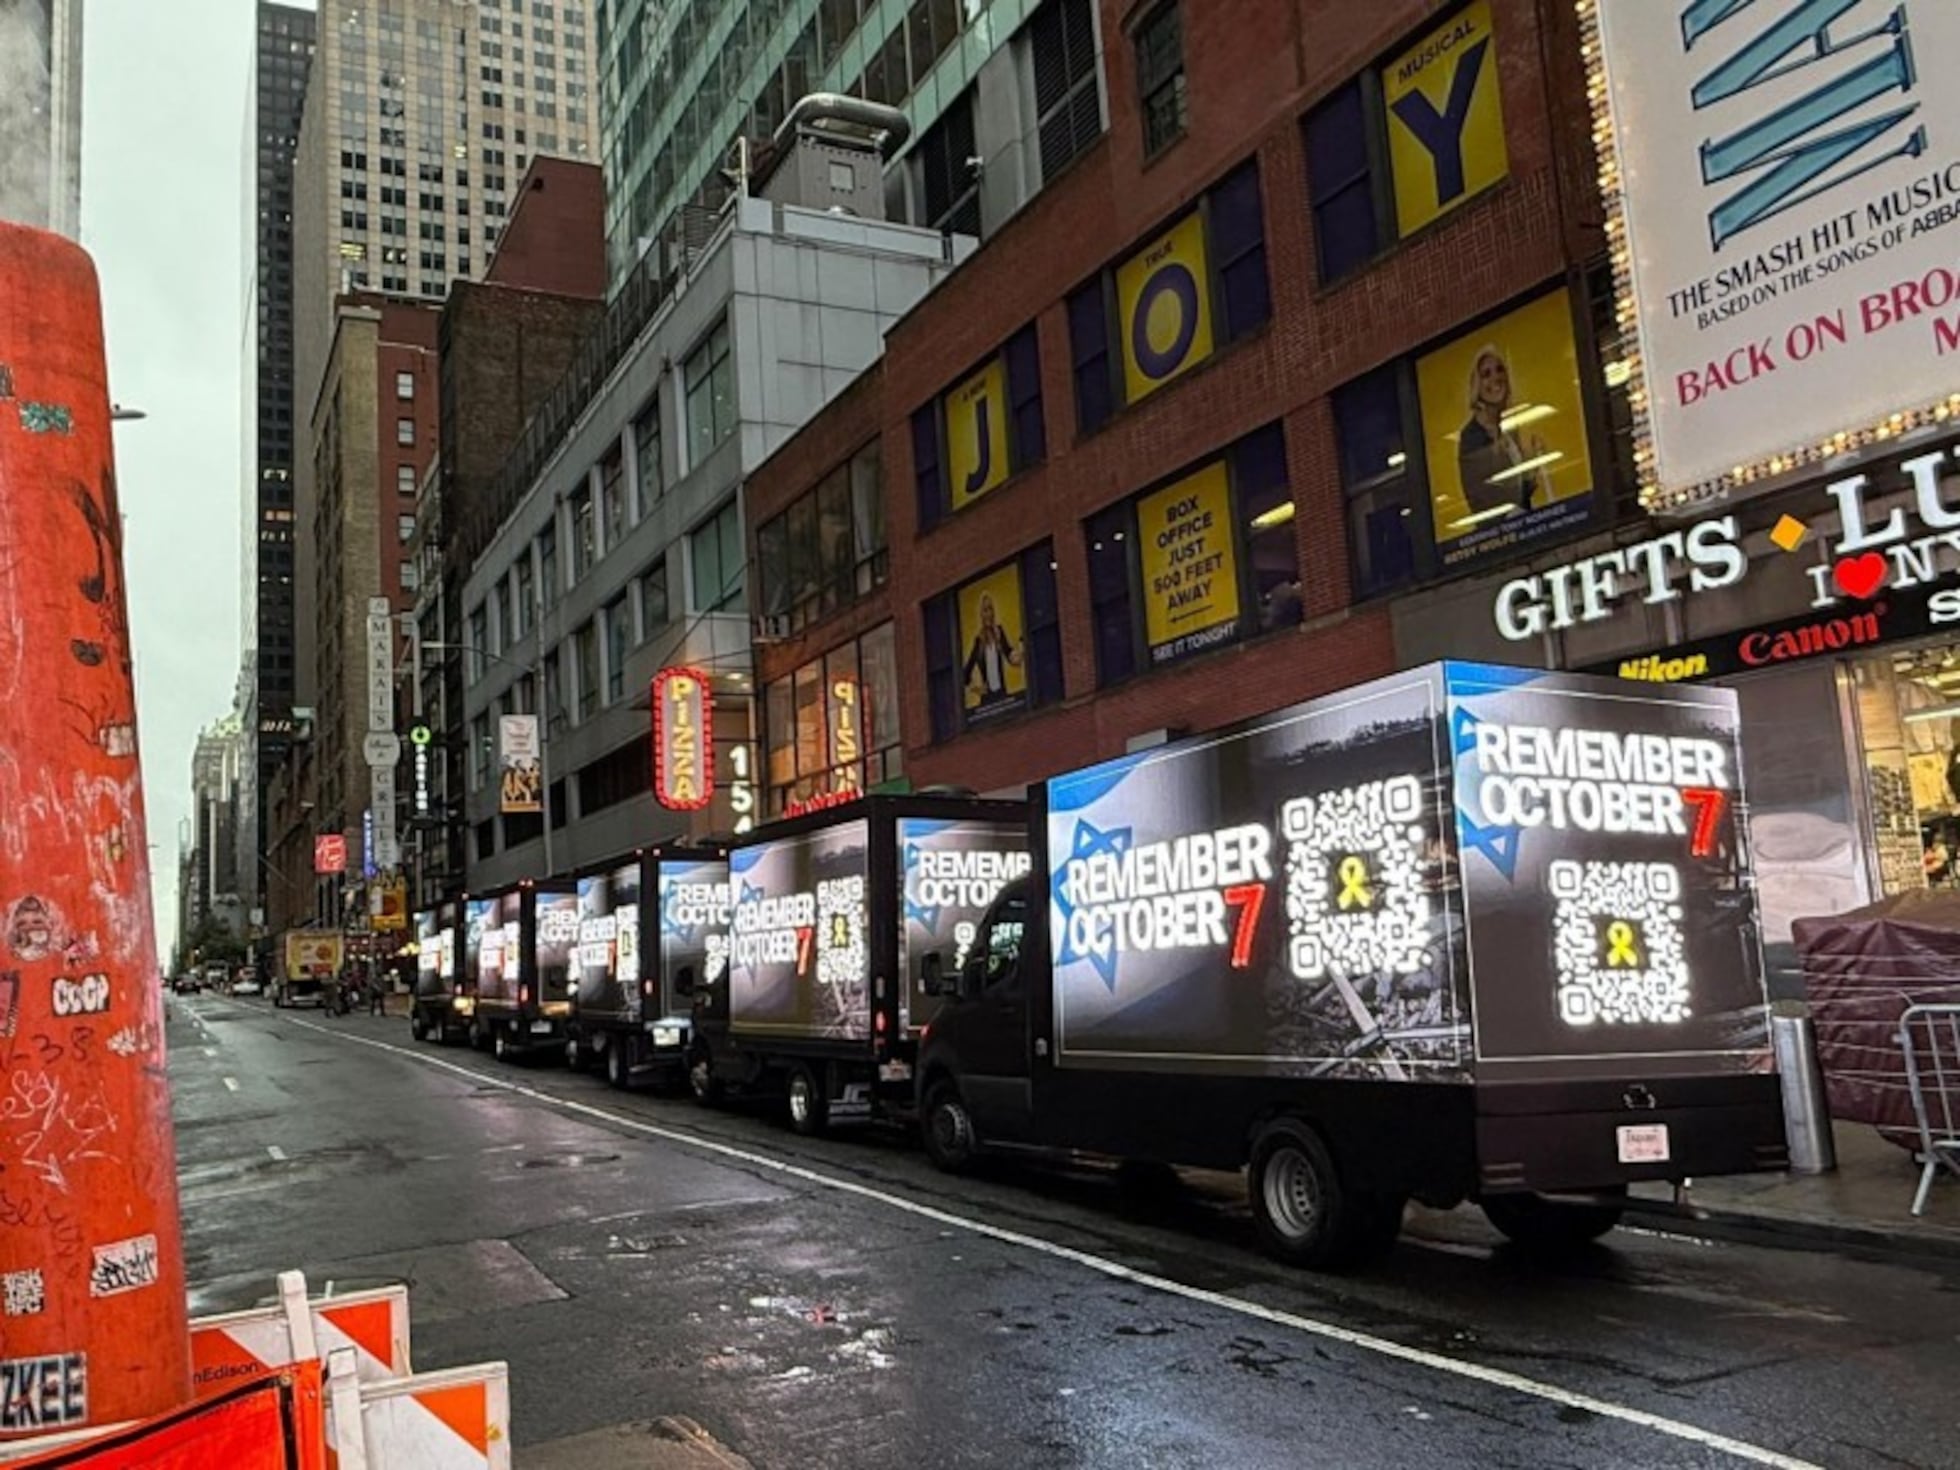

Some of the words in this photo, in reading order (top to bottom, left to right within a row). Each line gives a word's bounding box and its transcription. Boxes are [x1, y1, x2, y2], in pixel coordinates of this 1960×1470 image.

[1397, 20, 1475, 83] MUSICAL
[1389, 32, 1491, 208] Y
[1666, 279, 1713, 318] THE
[1715, 236, 1803, 298] SMASH
[1812, 209, 1857, 253] HIT
[1697, 293, 1751, 331] BASED
[1752, 282, 1777, 305] ON
[1780, 264, 1814, 293] THE
[1817, 235, 1879, 278] SONGS
[1881, 223, 1906, 249] OF
[1132, 265, 1198, 379] O
[1675, 336, 1776, 406] BACK
[1785, 308, 1847, 361] ON
[1860, 268, 1960, 334] BRO
[966, 396, 990, 492] J
[1157, 511, 1213, 548] OFFICE
[1166, 495, 1199, 523] BOX
[1153, 571, 1181, 594] 500
[1185, 552, 1223, 582] FEET
[1169, 539, 1204, 567] JUST
[1495, 515, 1744, 641] GIFTS
[1806, 565, 1836, 608] I
[1168, 578, 1213, 611] AWAY
[1176, 638, 1185, 655] IT
[1187, 622, 1236, 650] TONIGHT
[1619, 653, 1706, 682] Nikon
[1738, 612, 1880, 666] Canon
[669, 675, 697, 800] PIZZA
[1473, 723, 1729, 787] REMEMBER
[1479, 776, 1687, 836] OCTOBER
[1680, 787, 1725, 857] 7
[1065, 824, 1273, 907] REMEMBER
[1067, 889, 1229, 957] OCTOBER
[1224, 884, 1266, 968] 7
